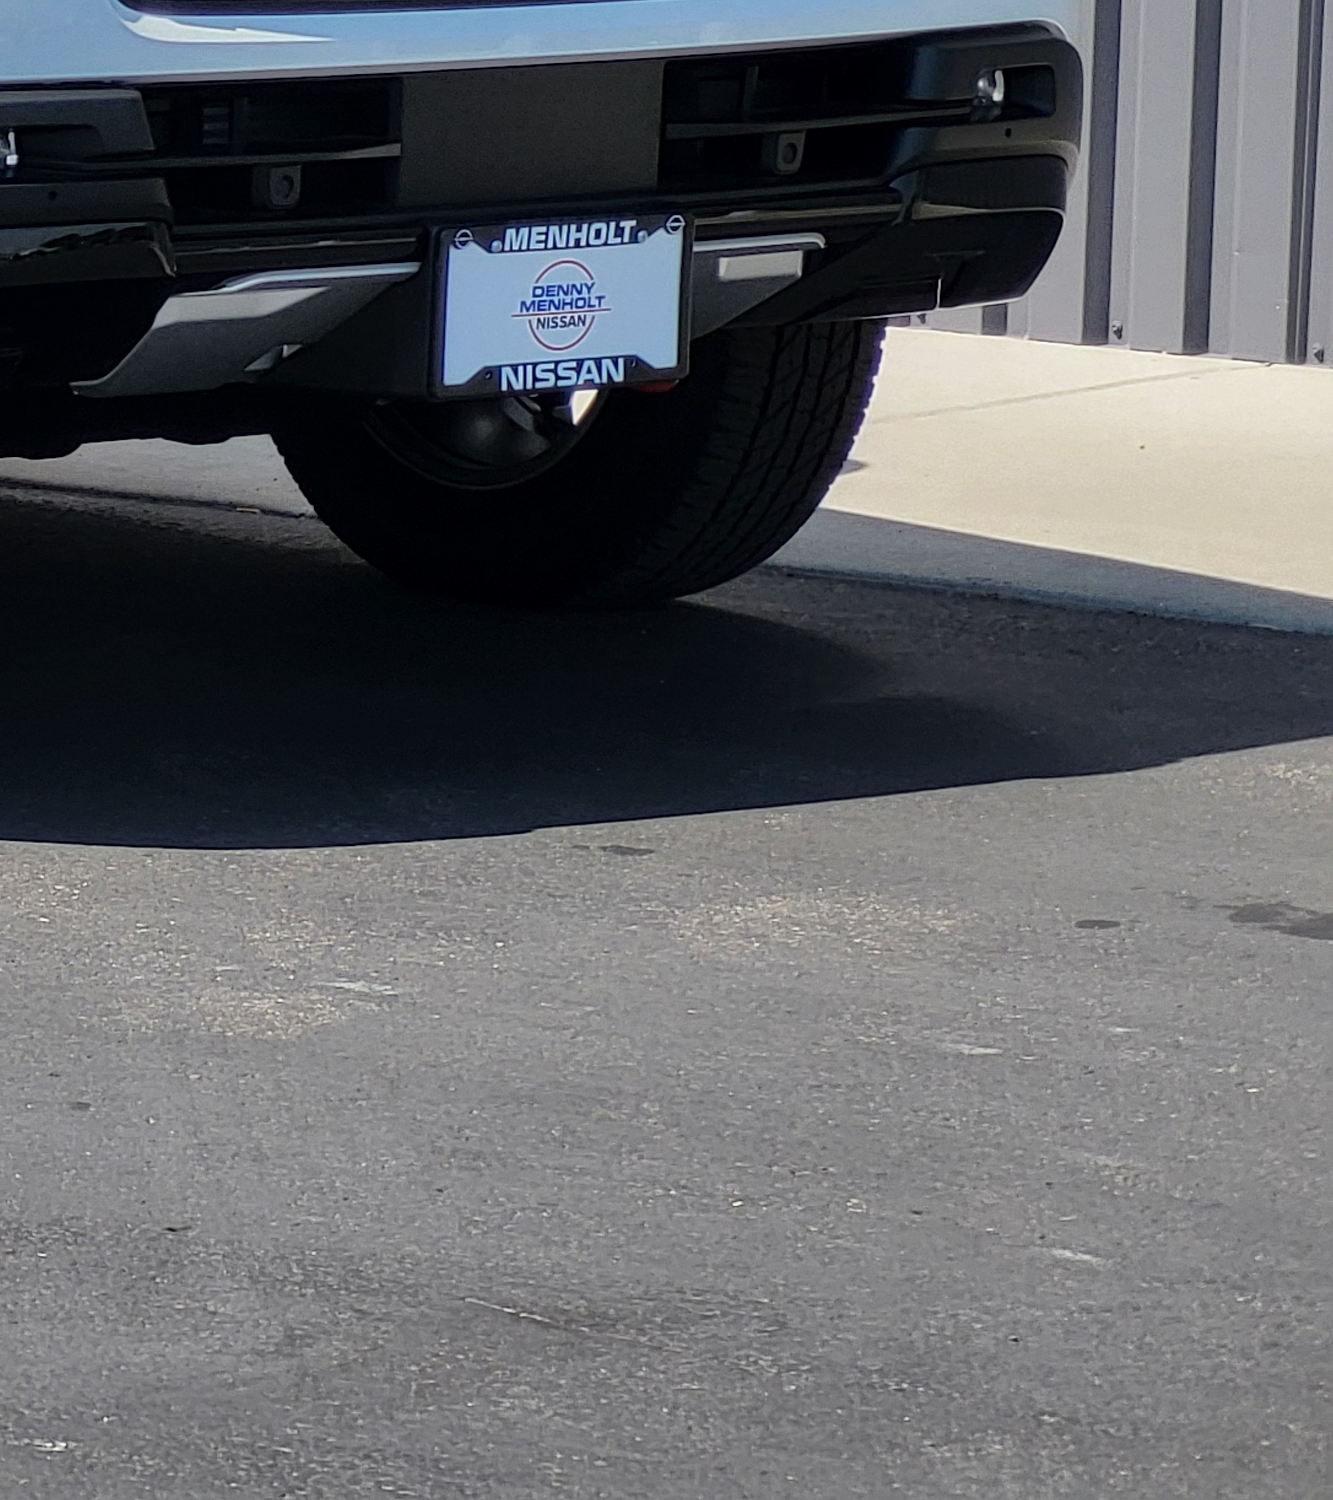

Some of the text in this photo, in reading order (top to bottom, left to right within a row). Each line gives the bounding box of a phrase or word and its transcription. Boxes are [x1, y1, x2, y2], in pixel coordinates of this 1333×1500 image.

[503, 219, 637, 251] MENHOLT
[531, 281, 596, 299] DENNY
[519, 295, 607, 313] MENHOLT
[535, 314, 587, 330] NISSAN
[500, 357, 625, 391] NISSAN
